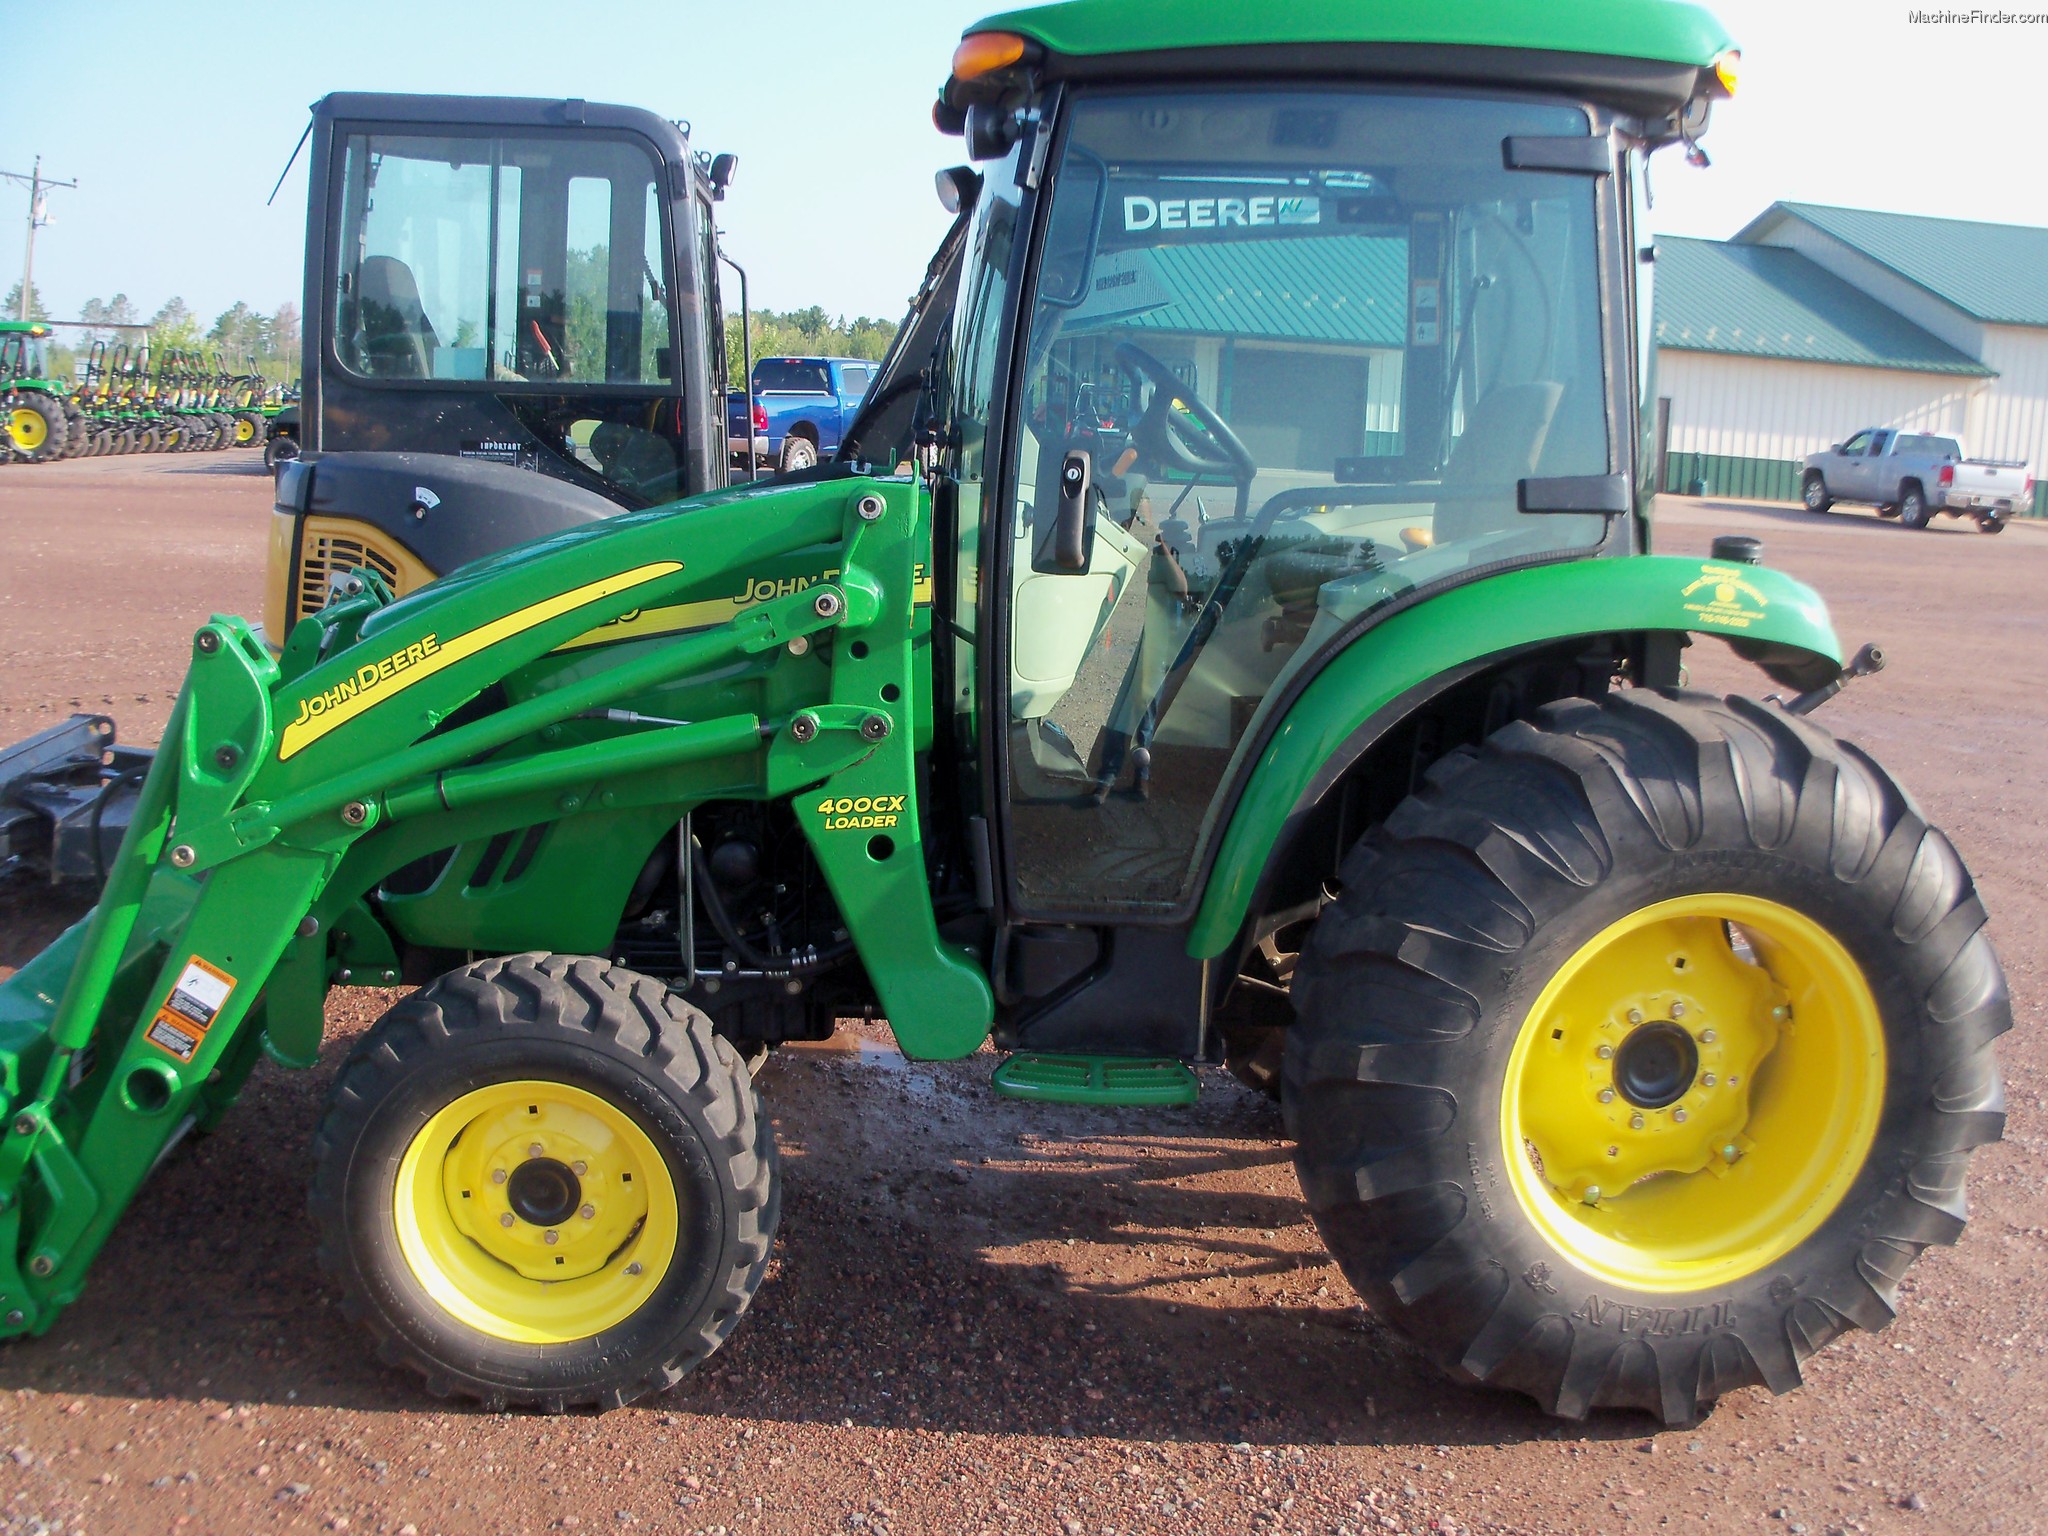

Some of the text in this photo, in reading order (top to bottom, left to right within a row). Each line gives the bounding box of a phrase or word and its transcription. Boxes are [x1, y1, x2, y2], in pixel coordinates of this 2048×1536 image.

[1124, 196, 1276, 231] DEERE
[295, 632, 441, 725] JOHN DEERE
[817, 795, 907, 815] 400CX
[825, 815, 898, 830] LOADER
[1571, 1293, 1737, 1339] TITAN
